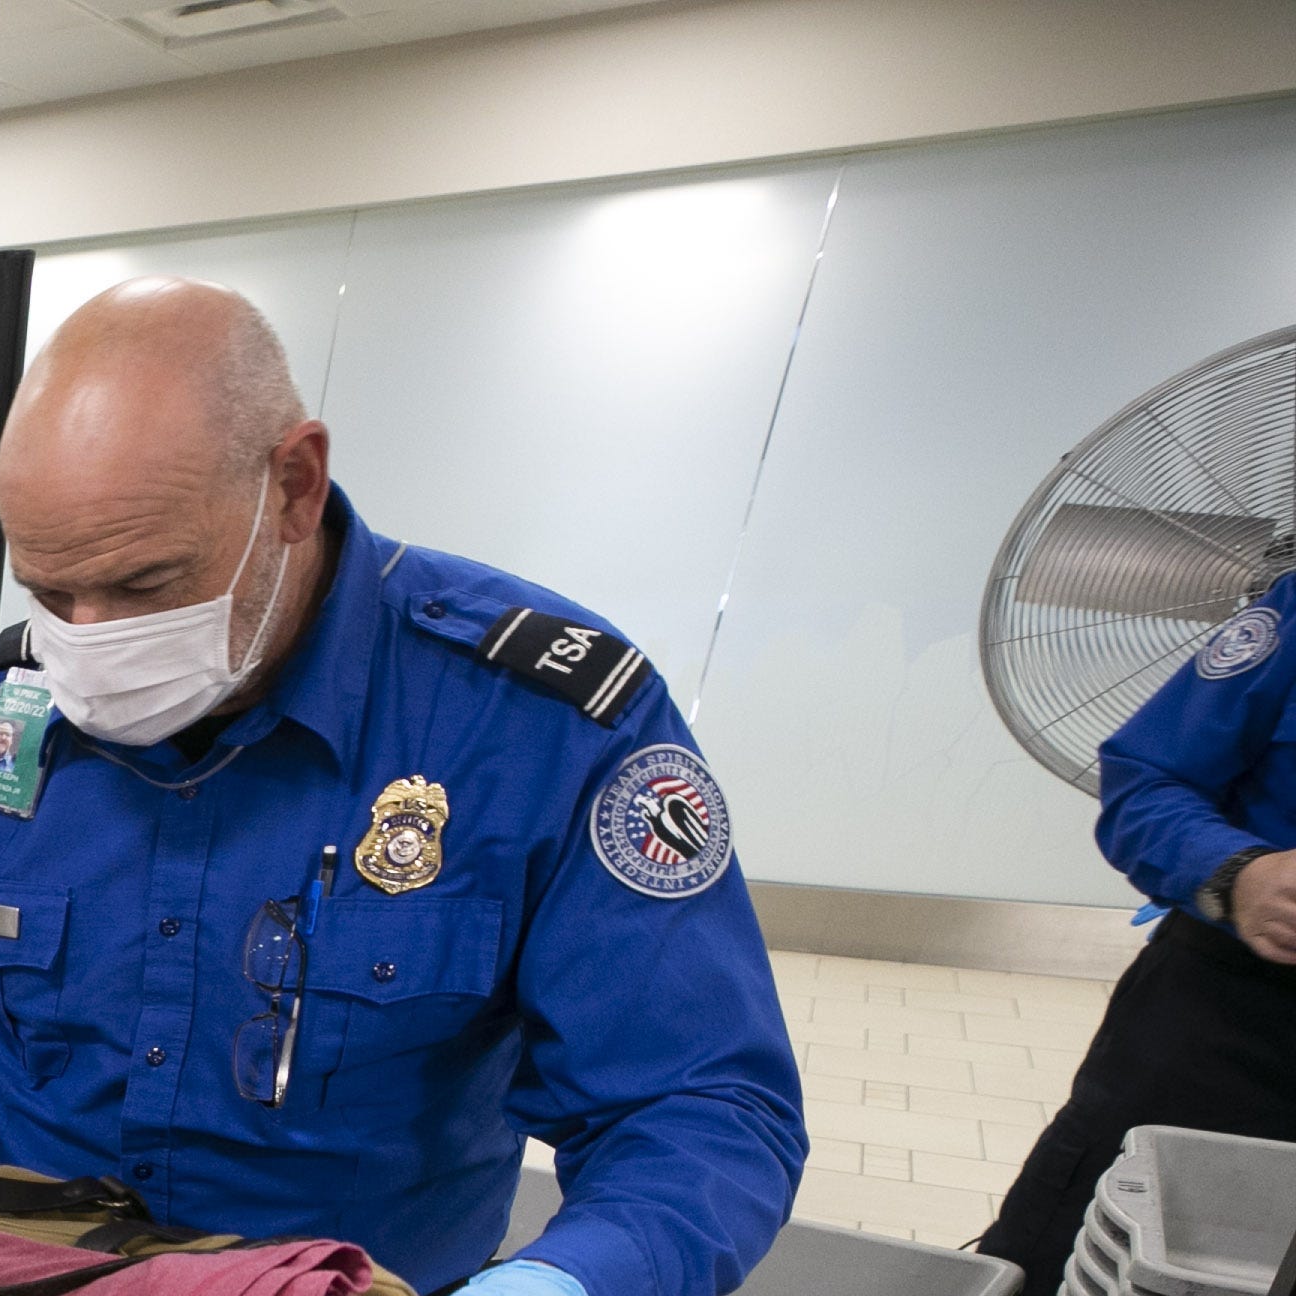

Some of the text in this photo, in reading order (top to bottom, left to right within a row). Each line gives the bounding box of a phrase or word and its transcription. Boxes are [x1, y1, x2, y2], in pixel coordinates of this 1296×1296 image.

[535, 626, 603, 676] TSA
[603, 752, 699, 806] TEAM SPIRIT
[599, 826, 687, 890] INTEGRITY
